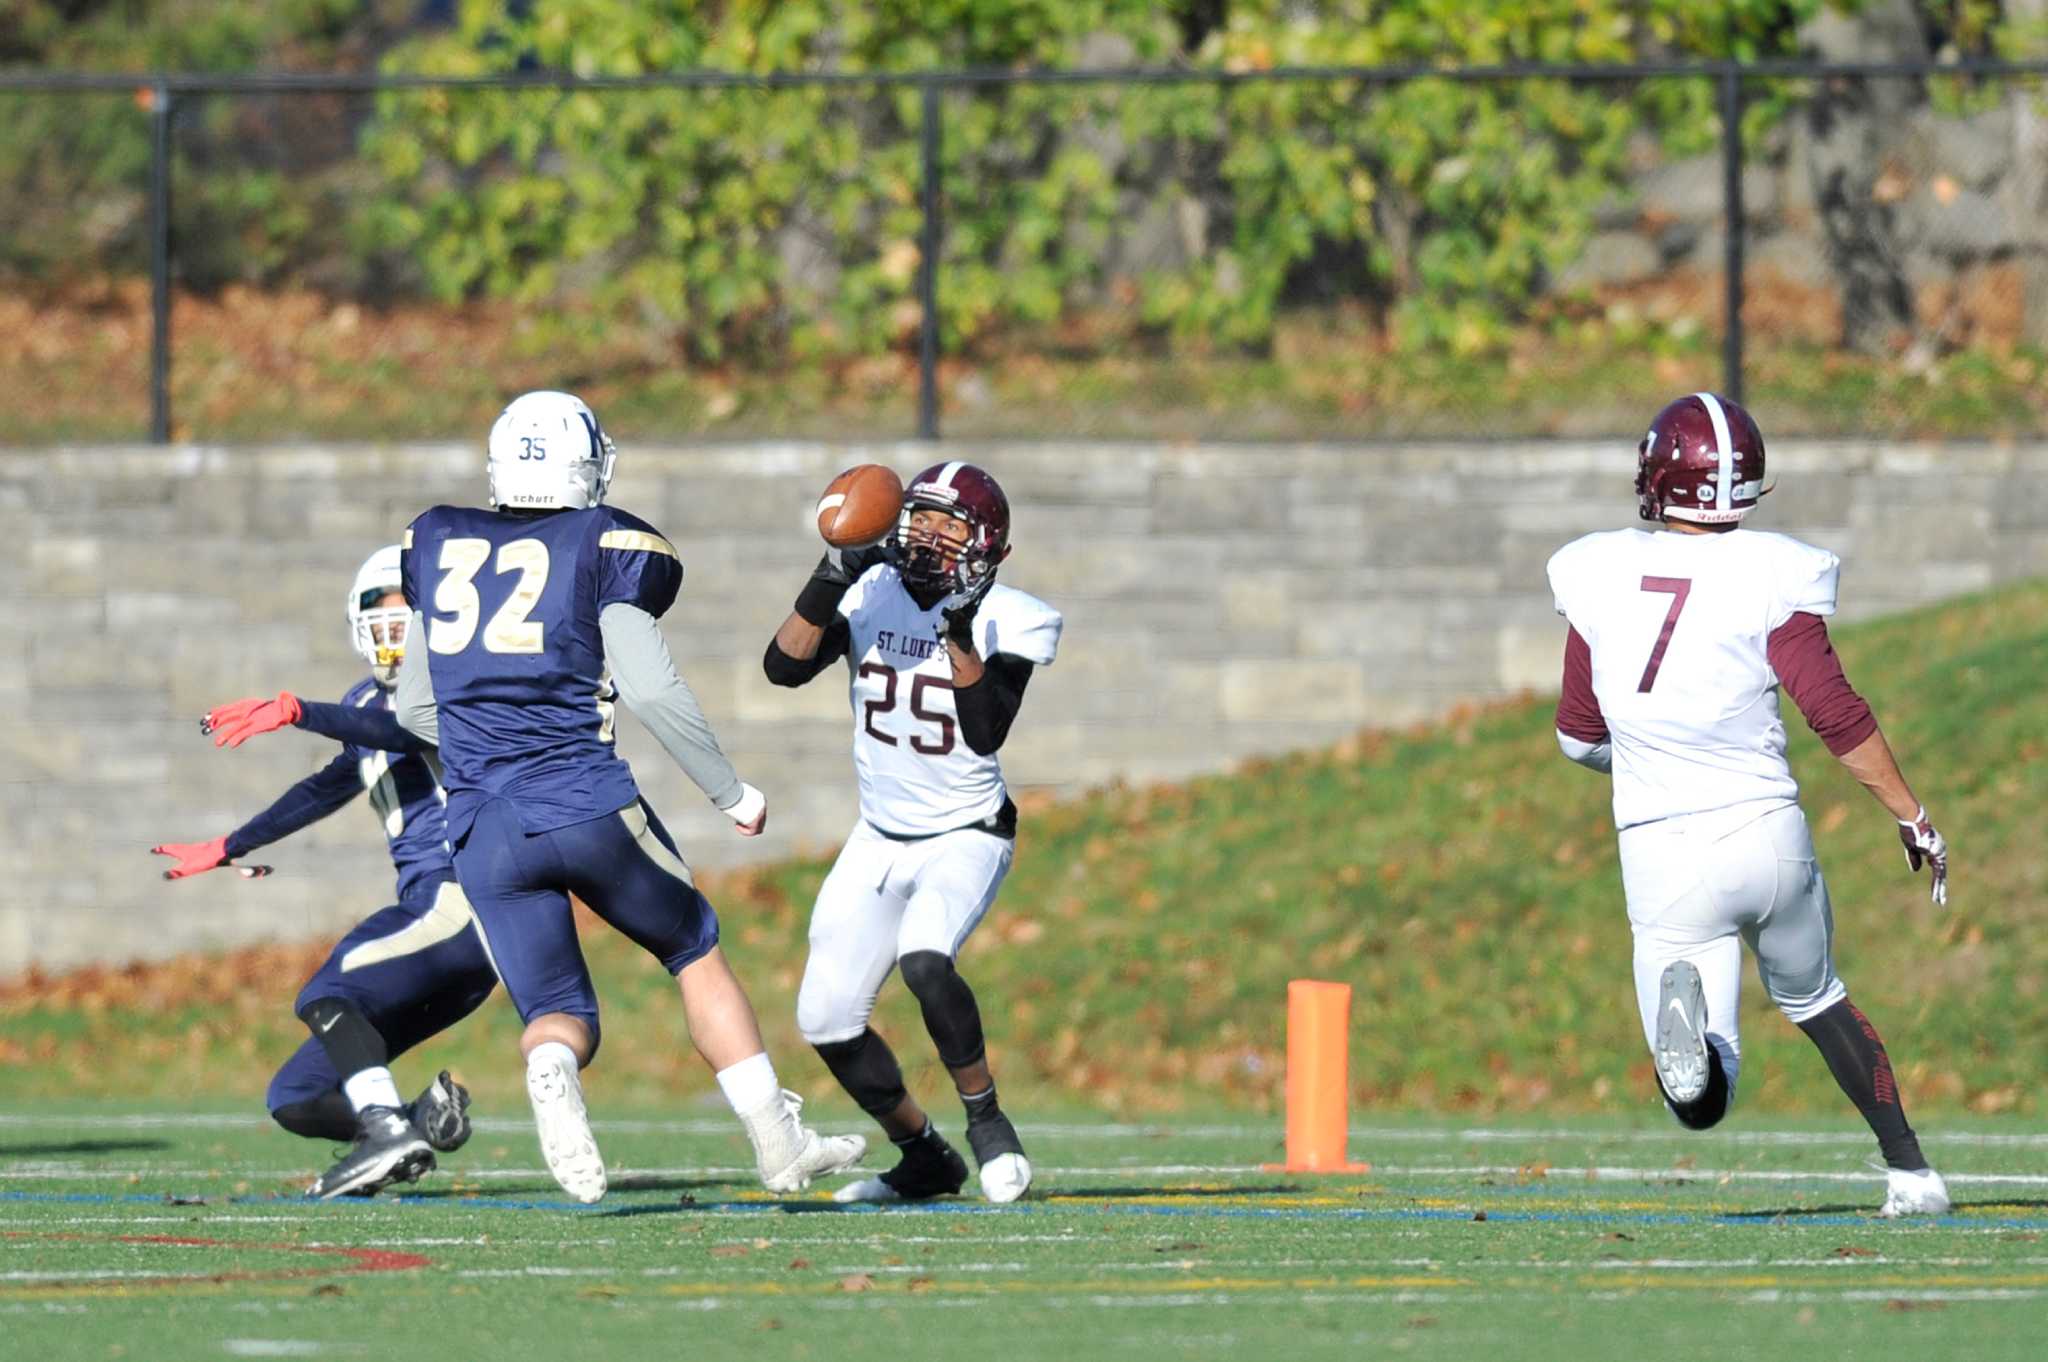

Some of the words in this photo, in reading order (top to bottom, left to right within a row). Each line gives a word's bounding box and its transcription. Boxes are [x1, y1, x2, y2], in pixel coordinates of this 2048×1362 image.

[519, 436, 546, 461] 35
[513, 494, 554, 503] schutt
[428, 538, 549, 655] 32
[877, 630, 896, 653] ST.
[1637, 576, 1692, 693] 7
[859, 661, 955, 755] 25
